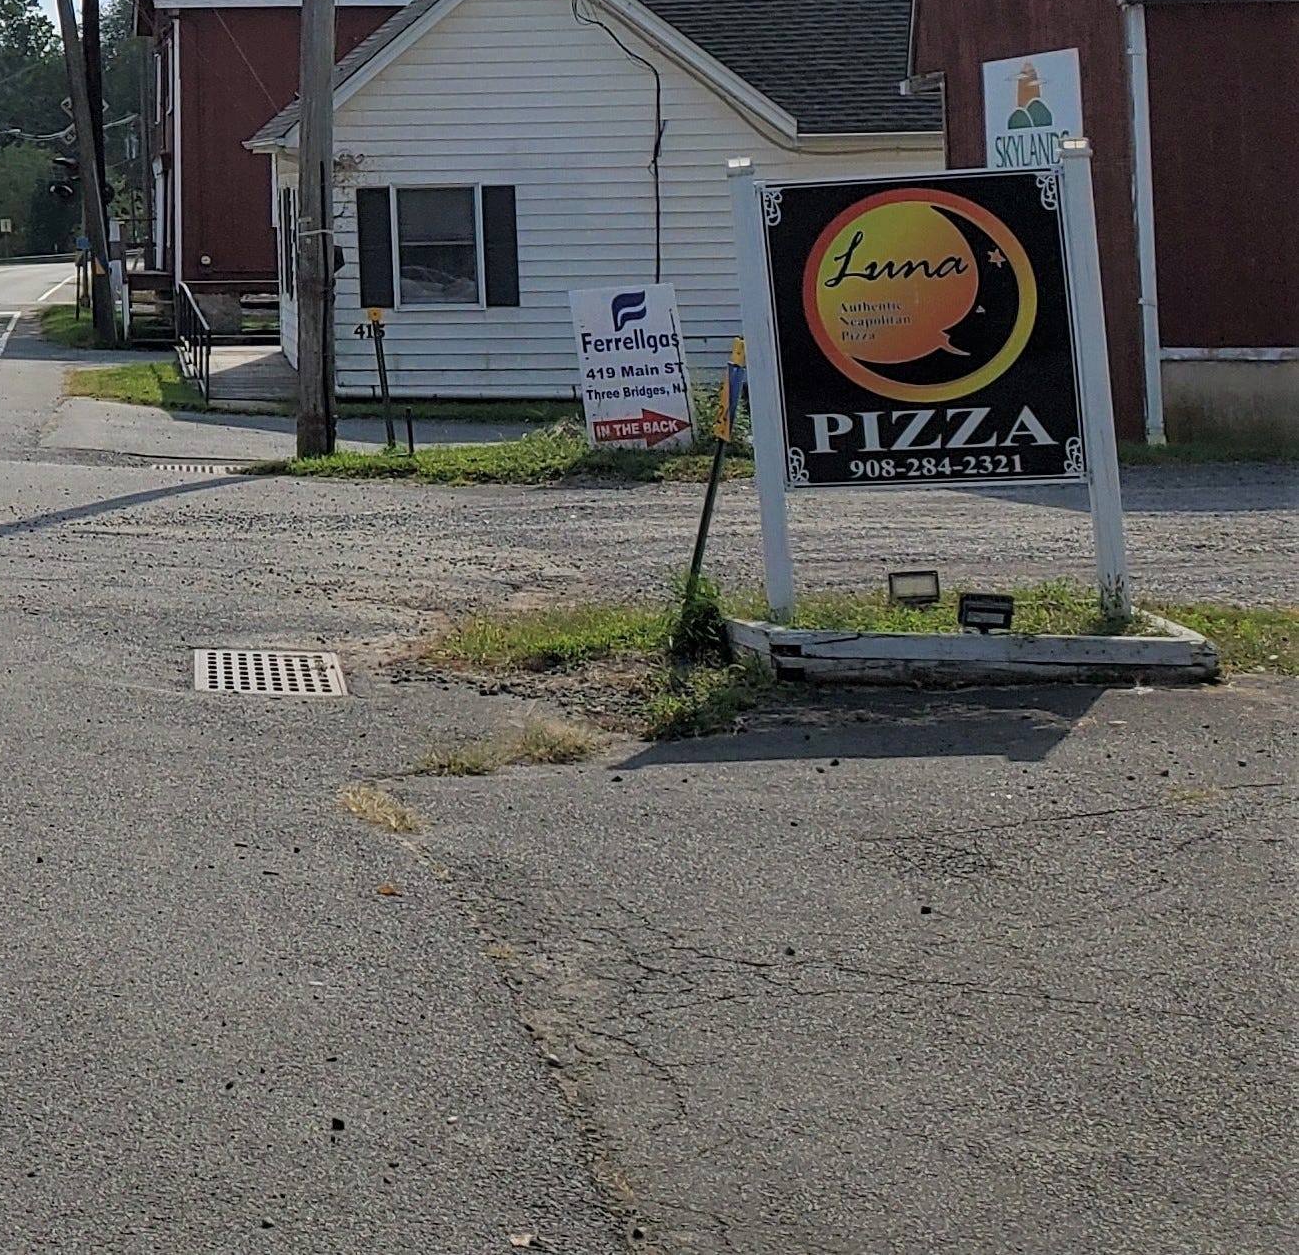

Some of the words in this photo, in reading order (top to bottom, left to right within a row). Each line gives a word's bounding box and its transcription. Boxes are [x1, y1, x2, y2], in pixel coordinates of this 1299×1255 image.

[824, 231, 968, 287] Luna
[840, 301, 903, 314] Authentic
[840, 315, 911, 328] Neapolitan
[581, 328, 680, 354] Ferrellgas
[841, 330, 876, 341] Pizza
[586, 367, 616, 380] 419
[621, 364, 660, 379] Main
[664, 361, 684, 375] ST
[586, 388, 620, 402] Three
[623, 385, 670, 399] Bridges,
[596, 425, 609, 438] IN
[614, 422, 640, 436] THE
[642, 419, 679, 435] BACK
[806, 405, 1059, 454] PIZZA
[851, 454, 1024, 479] 908-284-2321
